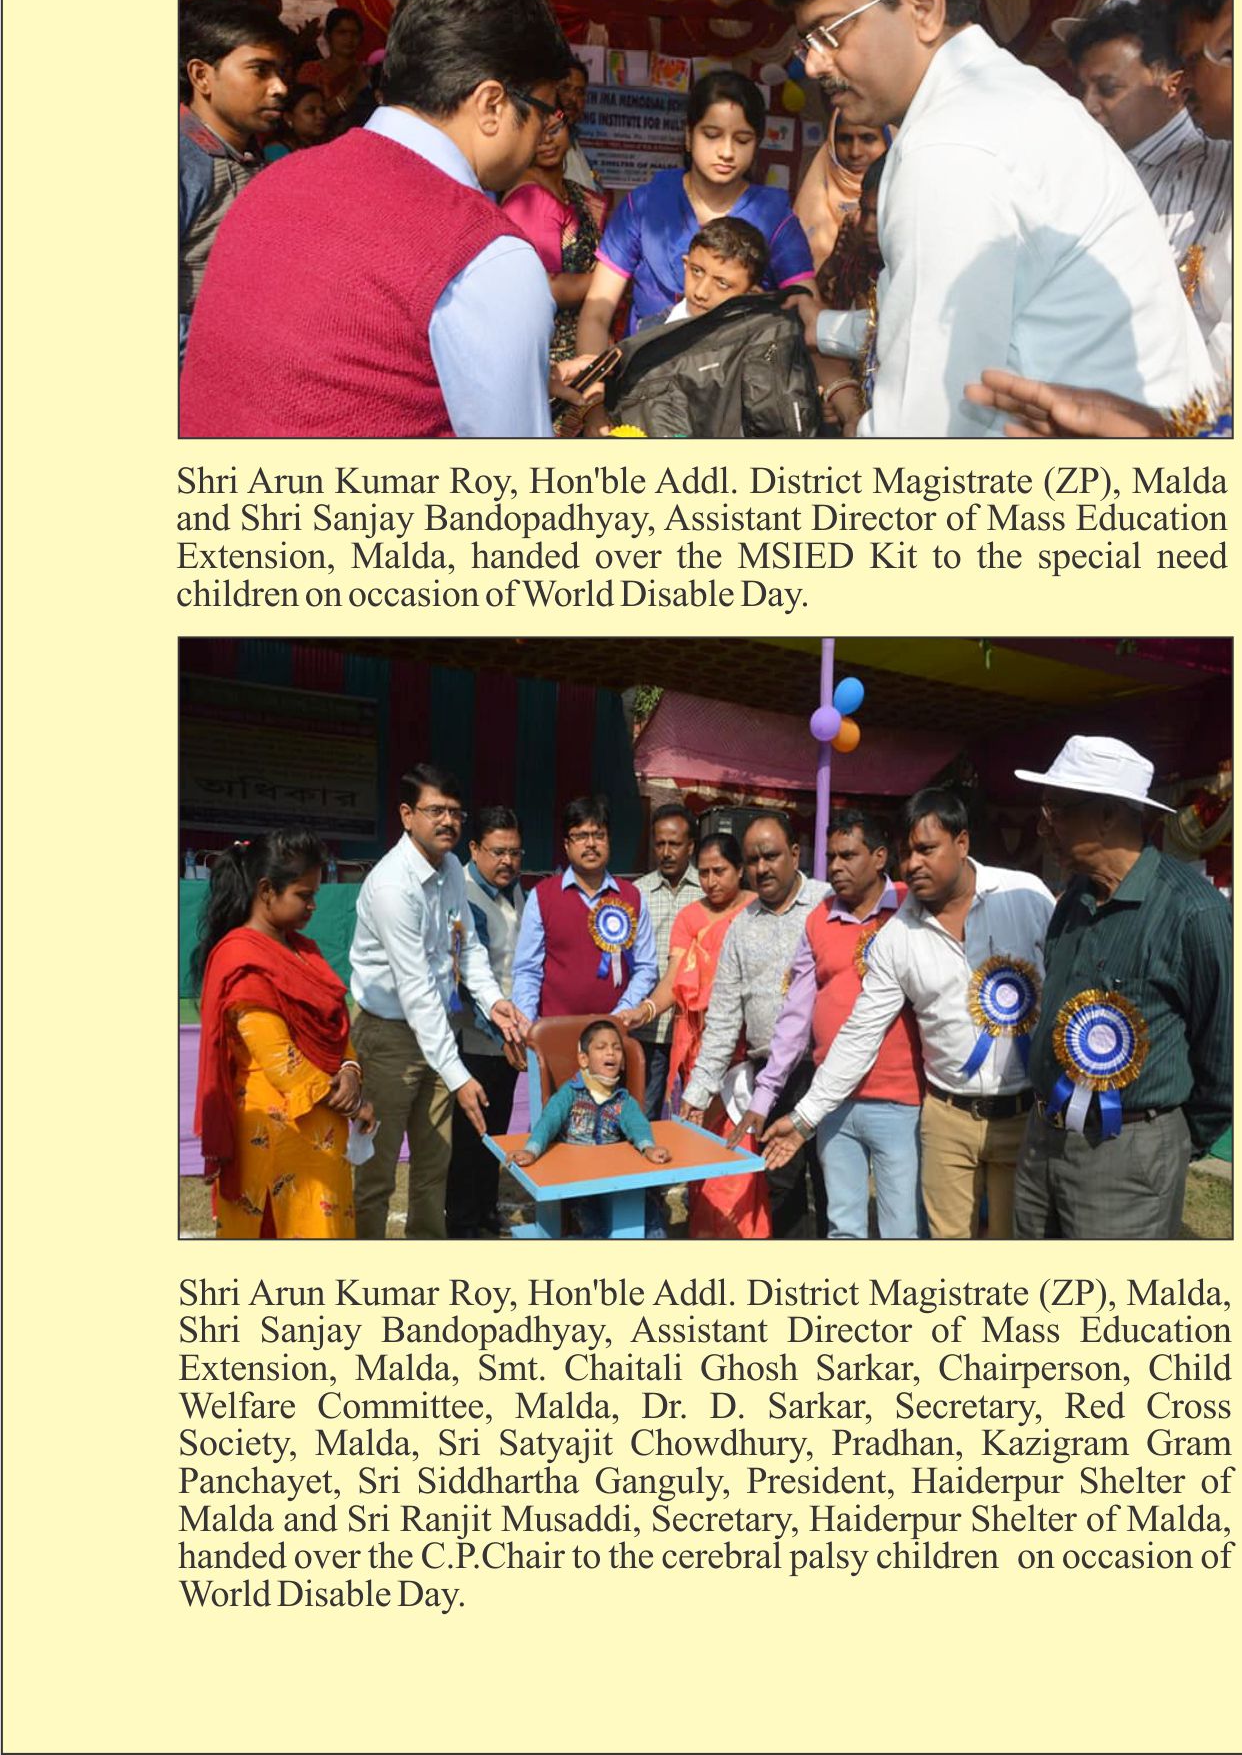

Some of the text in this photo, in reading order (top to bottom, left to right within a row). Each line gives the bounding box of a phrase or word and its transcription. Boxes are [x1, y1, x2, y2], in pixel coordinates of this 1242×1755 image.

[176, 540, 1229, 577] Extension, Malda, handed over the MSIED Kit to the special need
[194, 773, 358, 808] অধিকার
[178, 1465, 1237, 1502] Panchayet, Sri Siddhartha Ganguly, President, Haiderpur Shelter of
